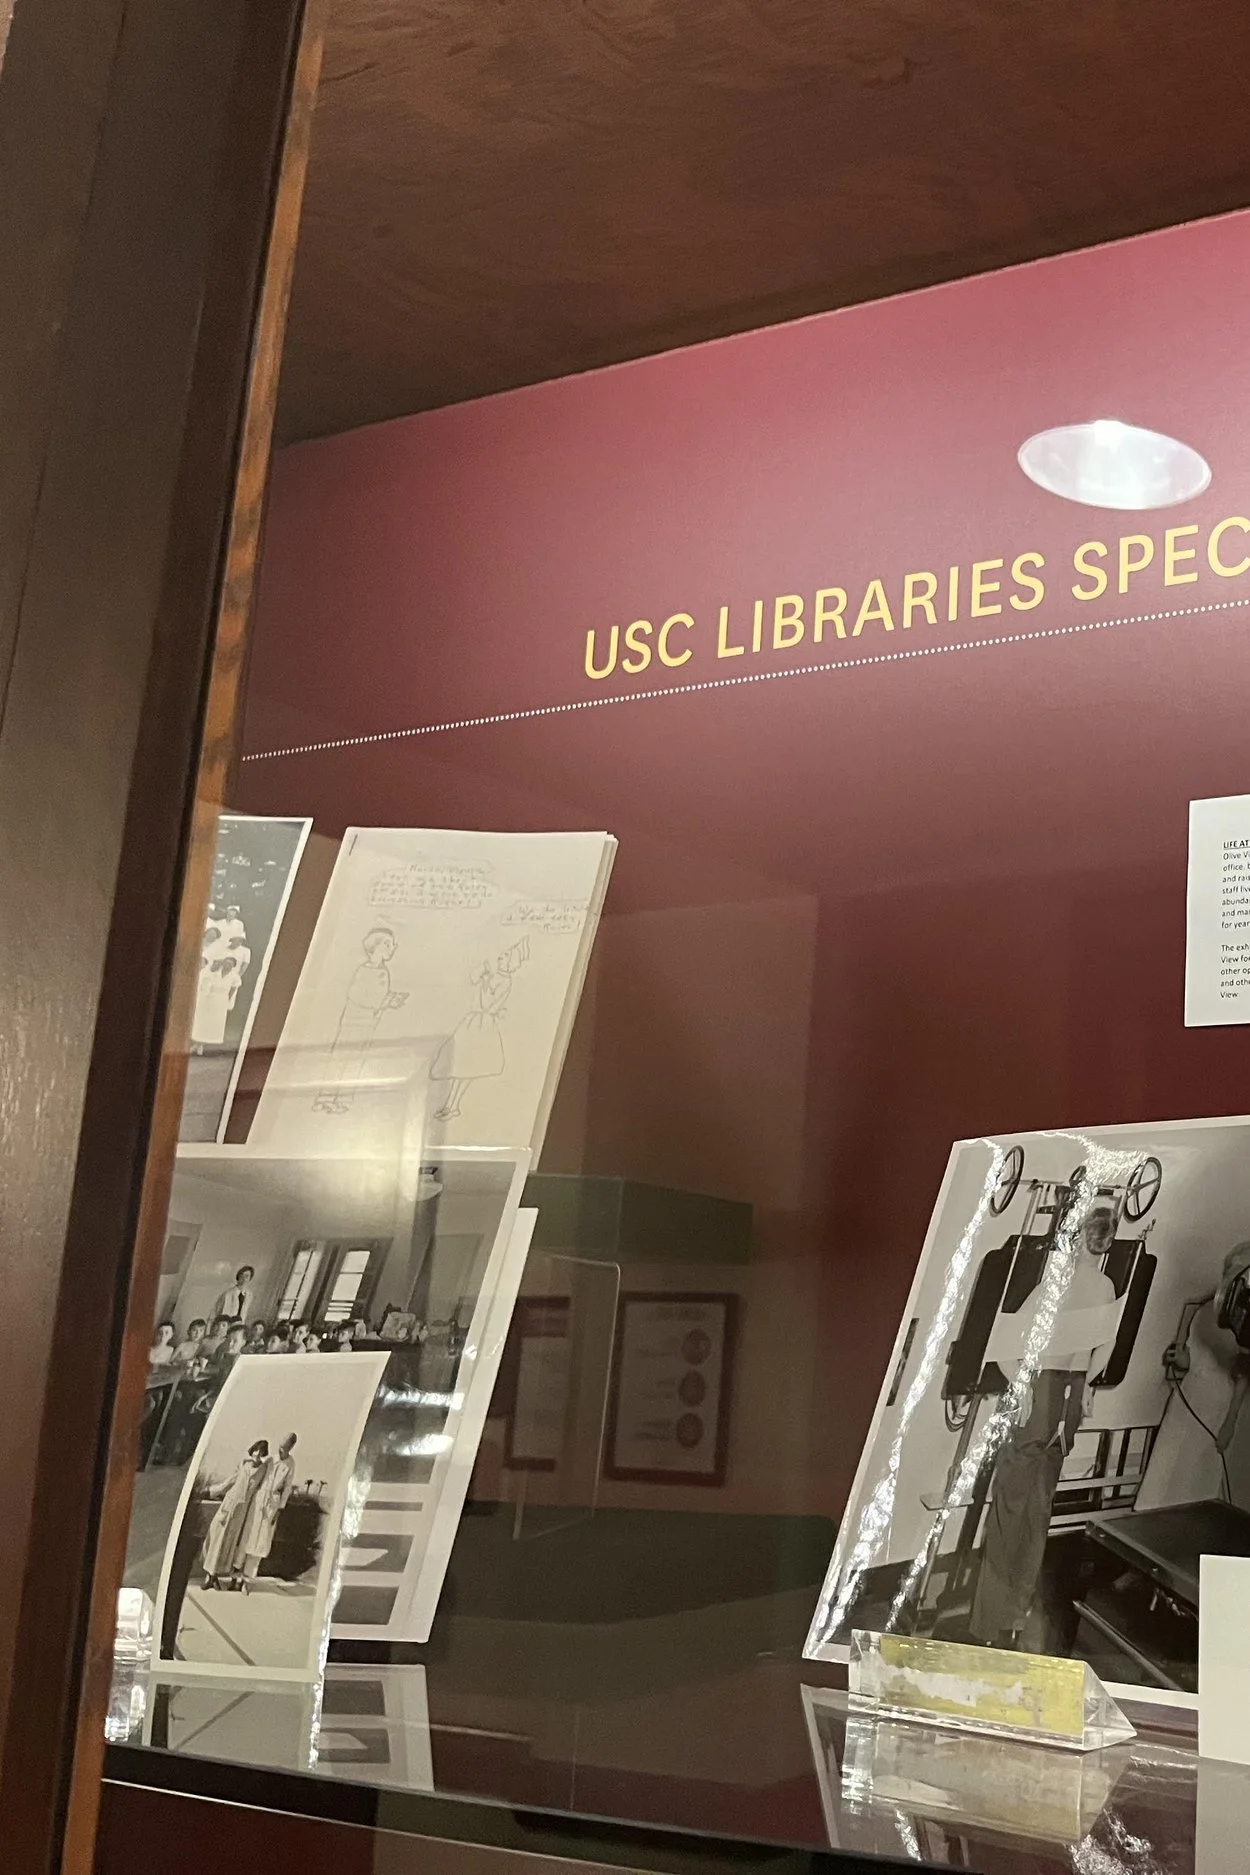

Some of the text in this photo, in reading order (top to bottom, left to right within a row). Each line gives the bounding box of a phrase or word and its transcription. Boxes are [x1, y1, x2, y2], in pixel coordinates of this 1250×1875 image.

[585, 613, 695, 679] USC
[716, 552, 1045, 658] LIBRARIES
[1222, 840, 1237, 849] LIFE
[1238, 838, 1249, 848] AT
[1221, 874, 1236, 883] and
[1220, 944, 1234, 952] The
